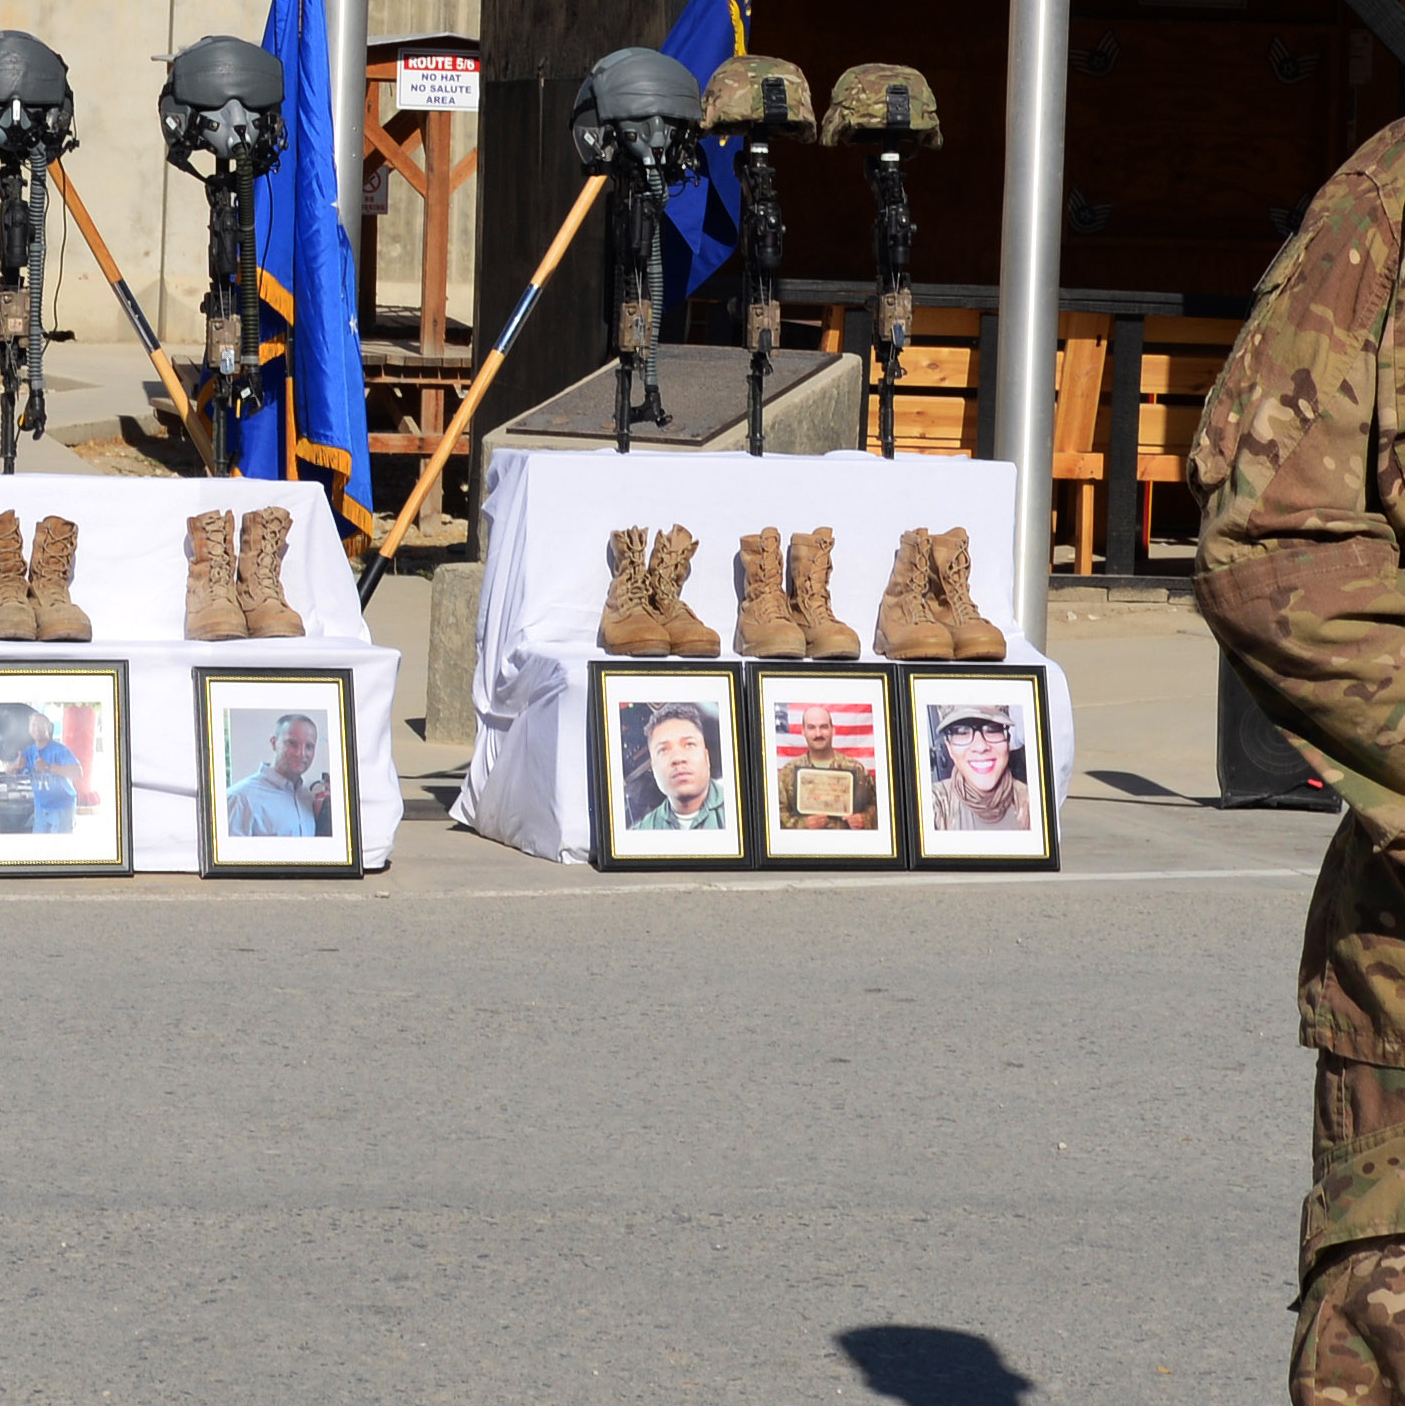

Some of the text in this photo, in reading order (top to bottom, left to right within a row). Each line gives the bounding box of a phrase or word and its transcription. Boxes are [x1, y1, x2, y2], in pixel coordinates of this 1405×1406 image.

[408, 56, 475, 71] ROUTE 5/6
[421, 73, 461, 82] NO HAT
[410, 83, 472, 94] NO SALUTE
[426, 95, 456, 105] AREA
